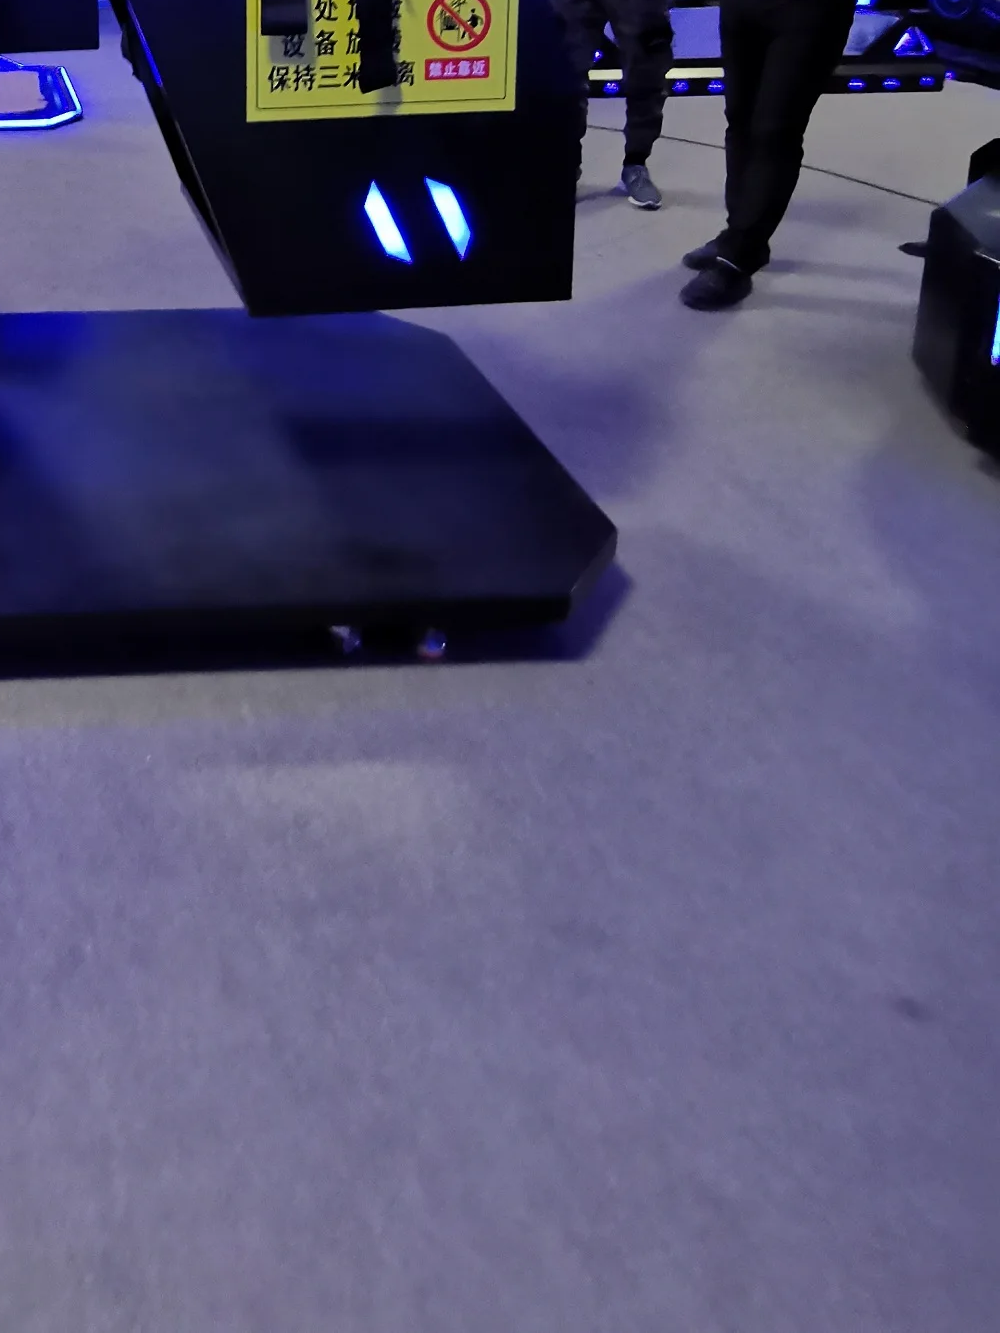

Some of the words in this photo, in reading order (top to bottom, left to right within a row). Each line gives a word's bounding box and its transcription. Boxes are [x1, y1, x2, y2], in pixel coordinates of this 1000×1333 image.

[267, 60, 415, 93] 保持三米离
